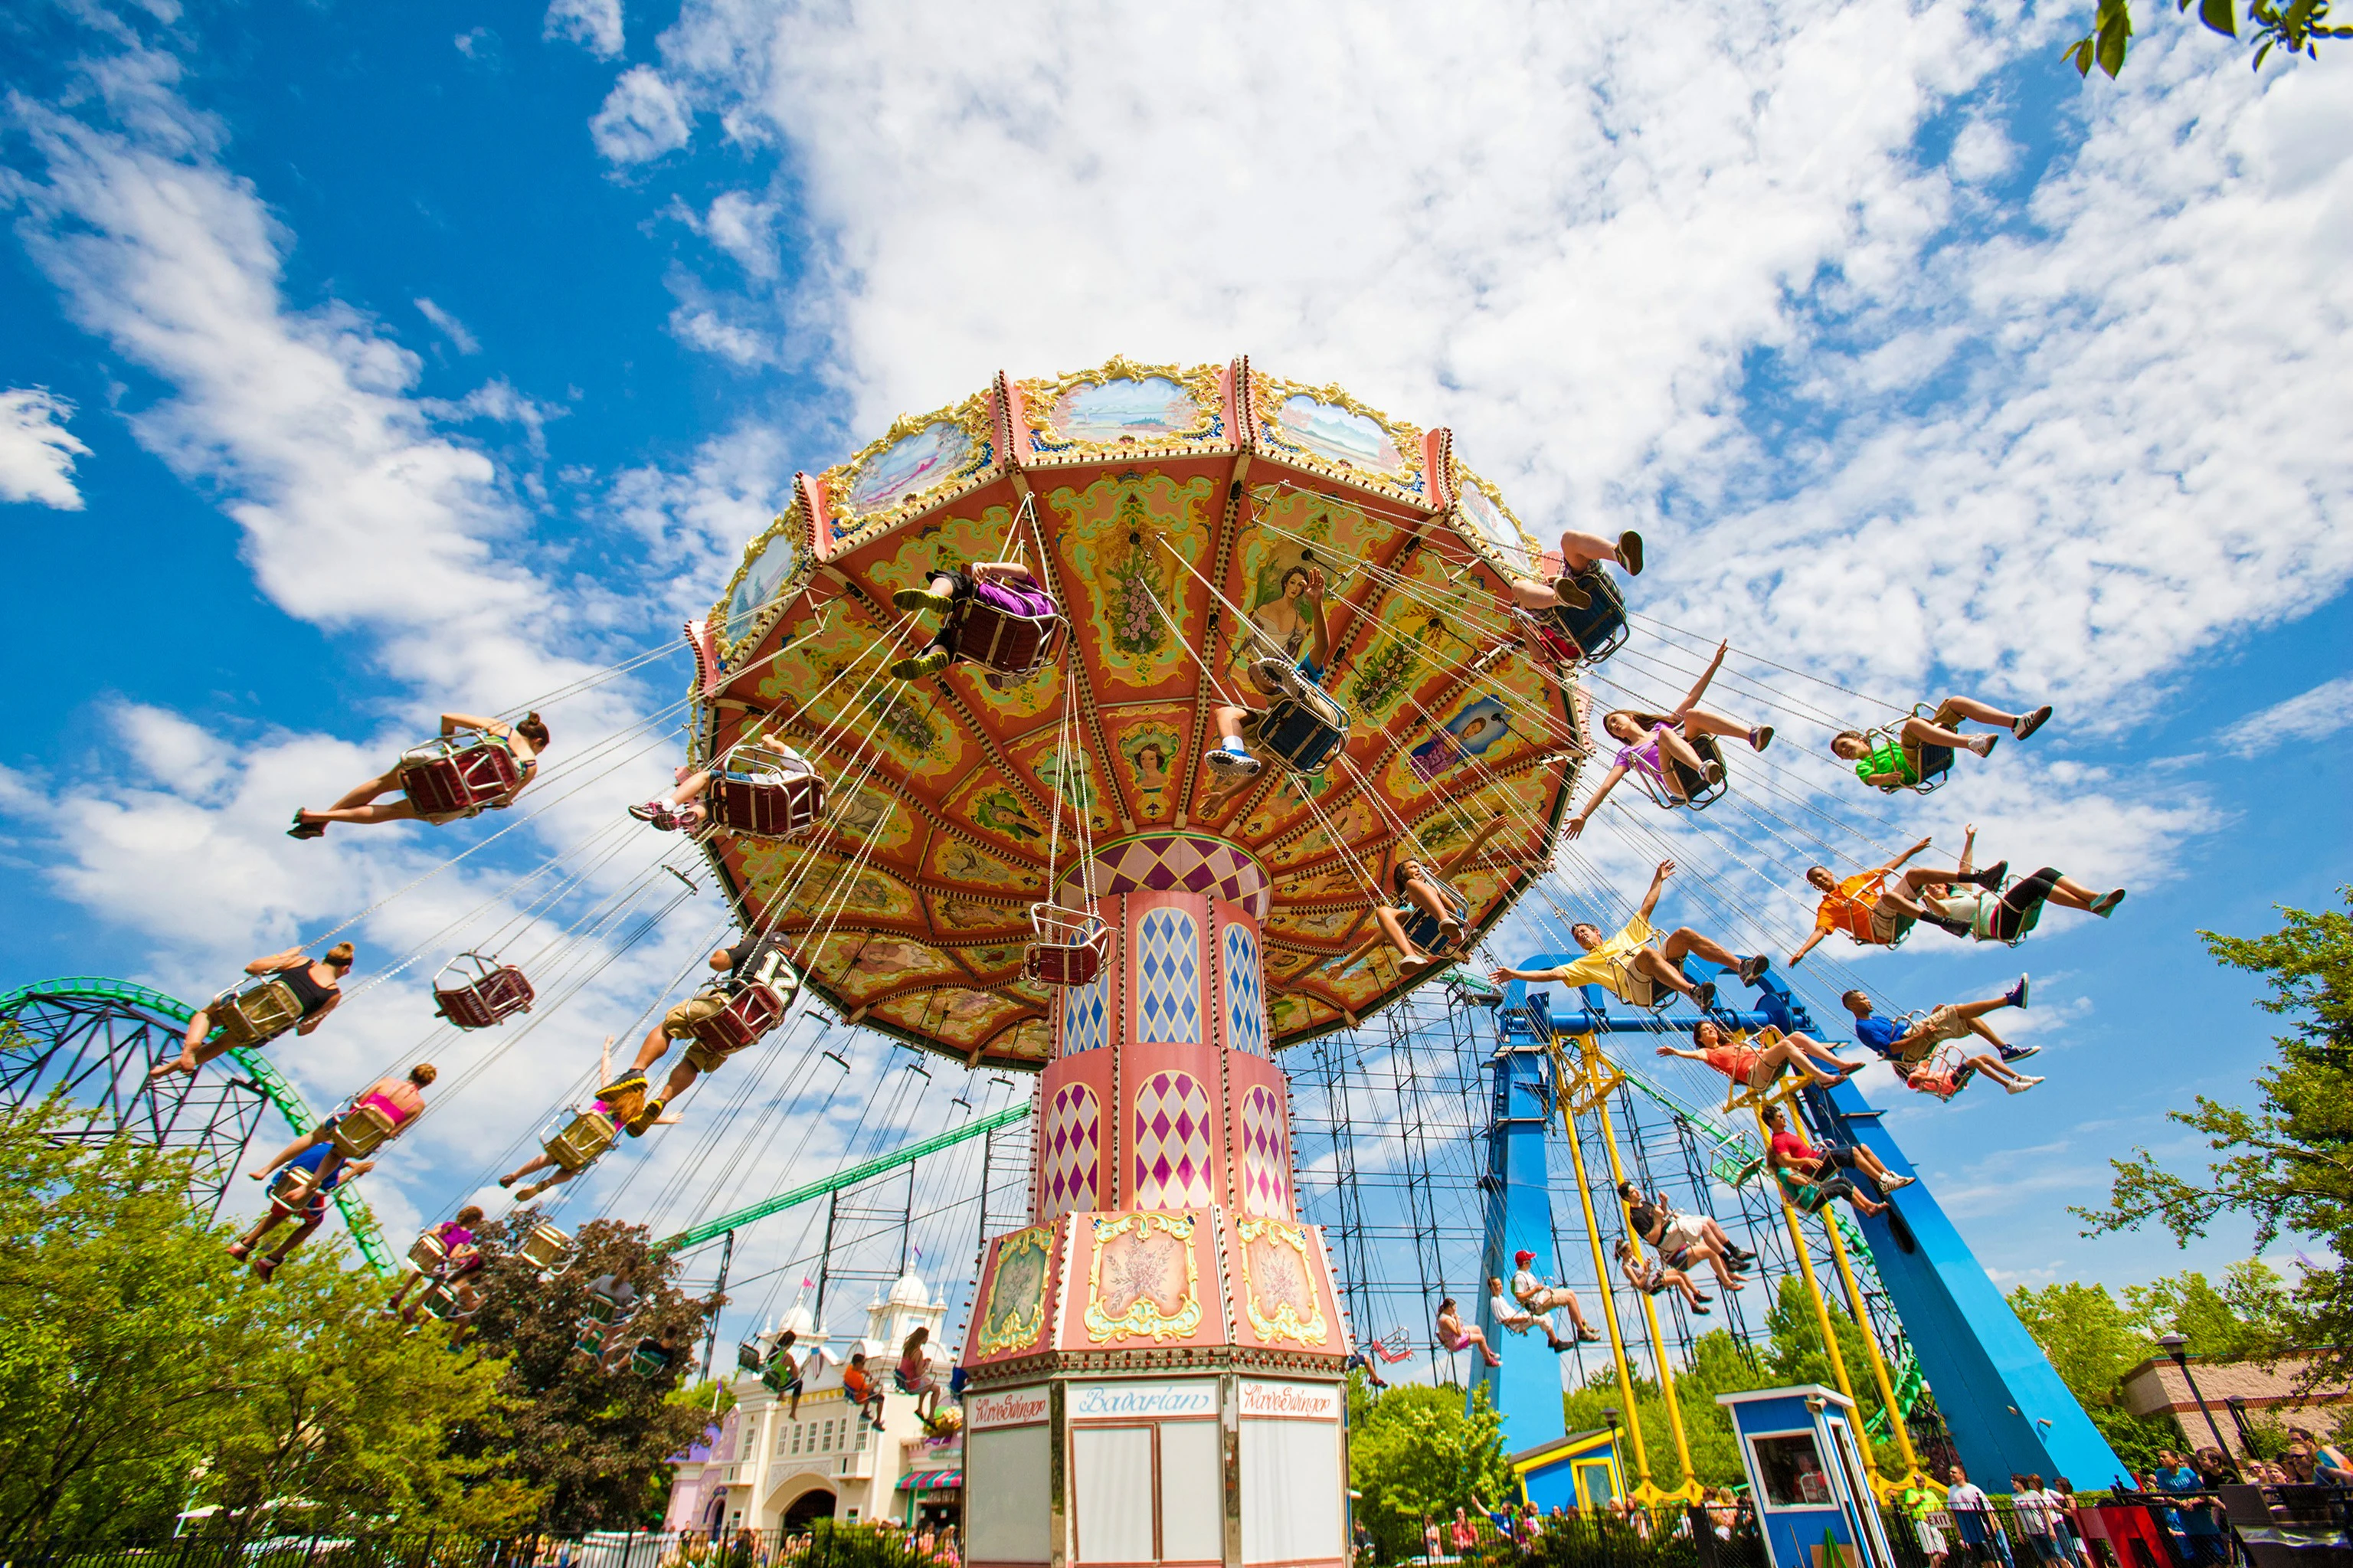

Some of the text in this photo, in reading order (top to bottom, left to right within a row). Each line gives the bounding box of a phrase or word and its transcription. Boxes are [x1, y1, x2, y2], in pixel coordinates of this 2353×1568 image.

[754, 950, 798, 1007] 12
[1078, 1386, 1209, 1413] Bavarian
[1927, 1514, 1948, 1525] EXIT
